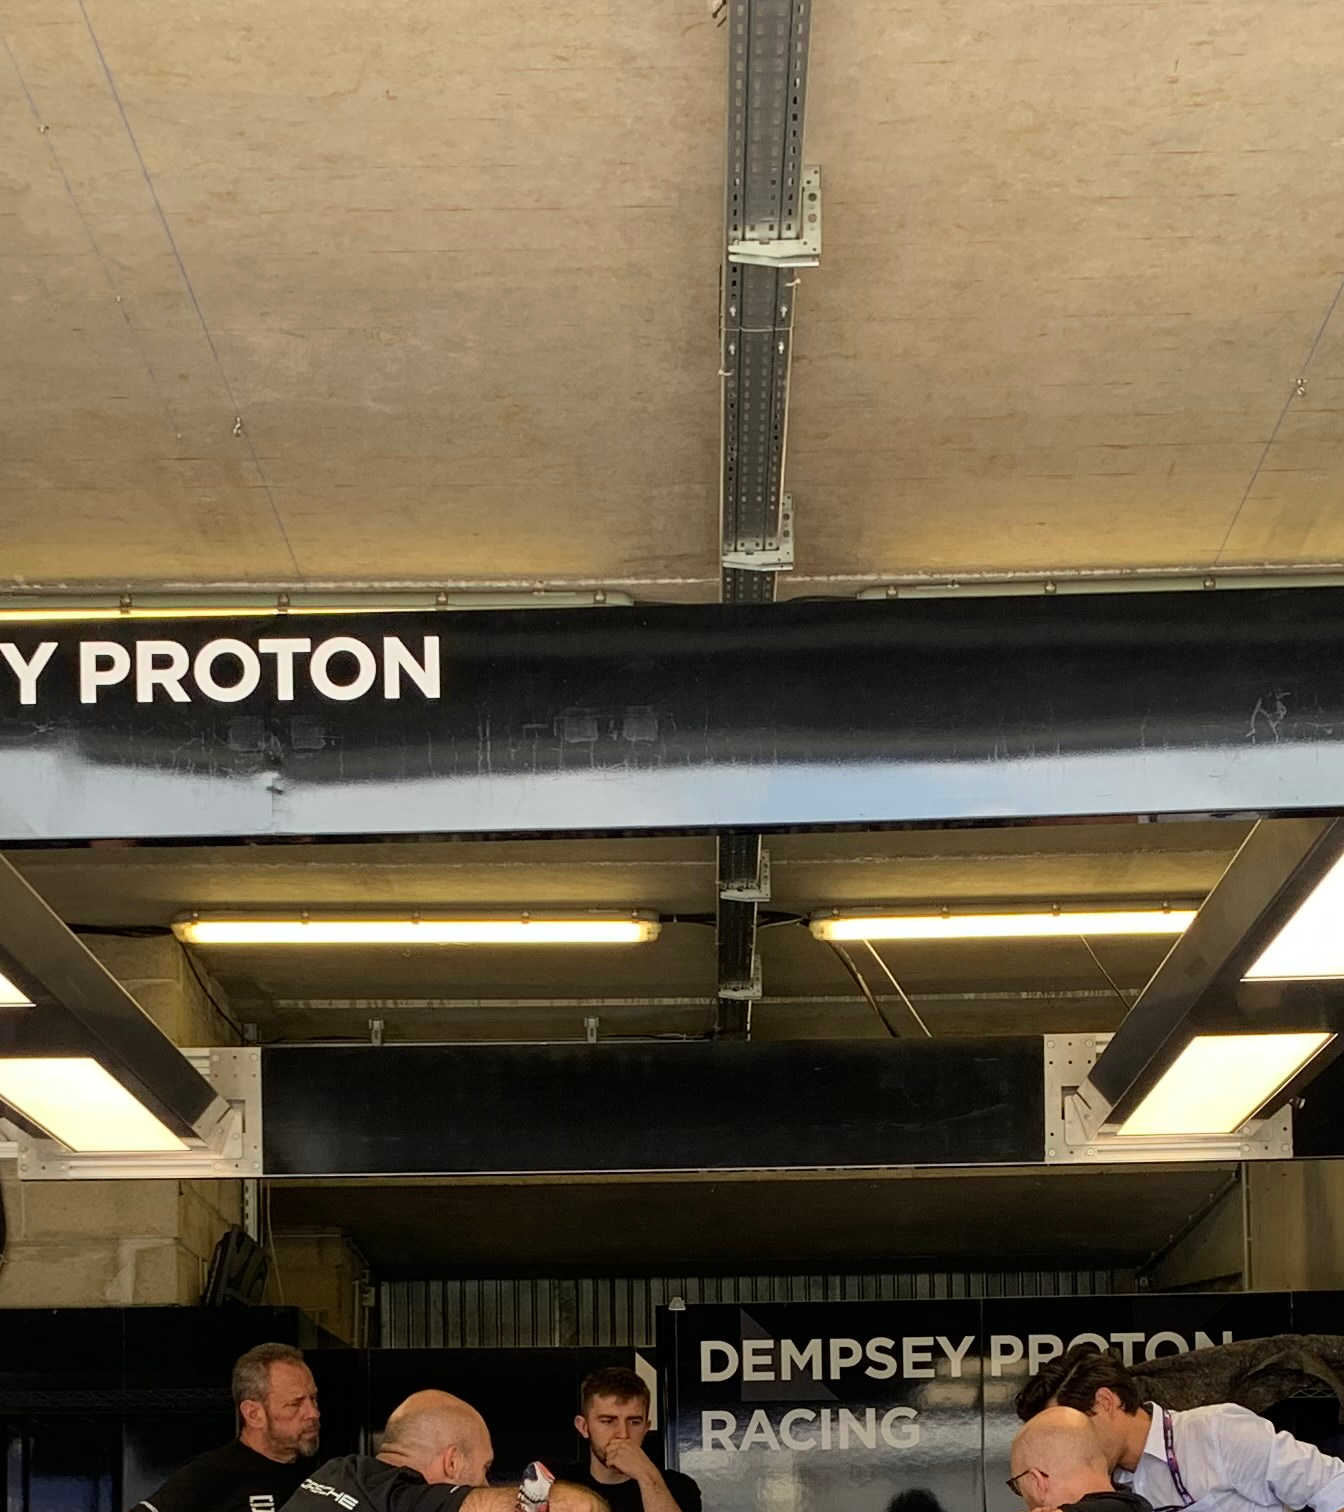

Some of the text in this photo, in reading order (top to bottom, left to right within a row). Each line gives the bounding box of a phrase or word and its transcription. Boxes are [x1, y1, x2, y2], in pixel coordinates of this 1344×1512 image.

[79, 635, 442, 704] PROTON
[700, 1336, 975, 1382] DEMPSEY
[701, 1407, 921, 1451] RACING
